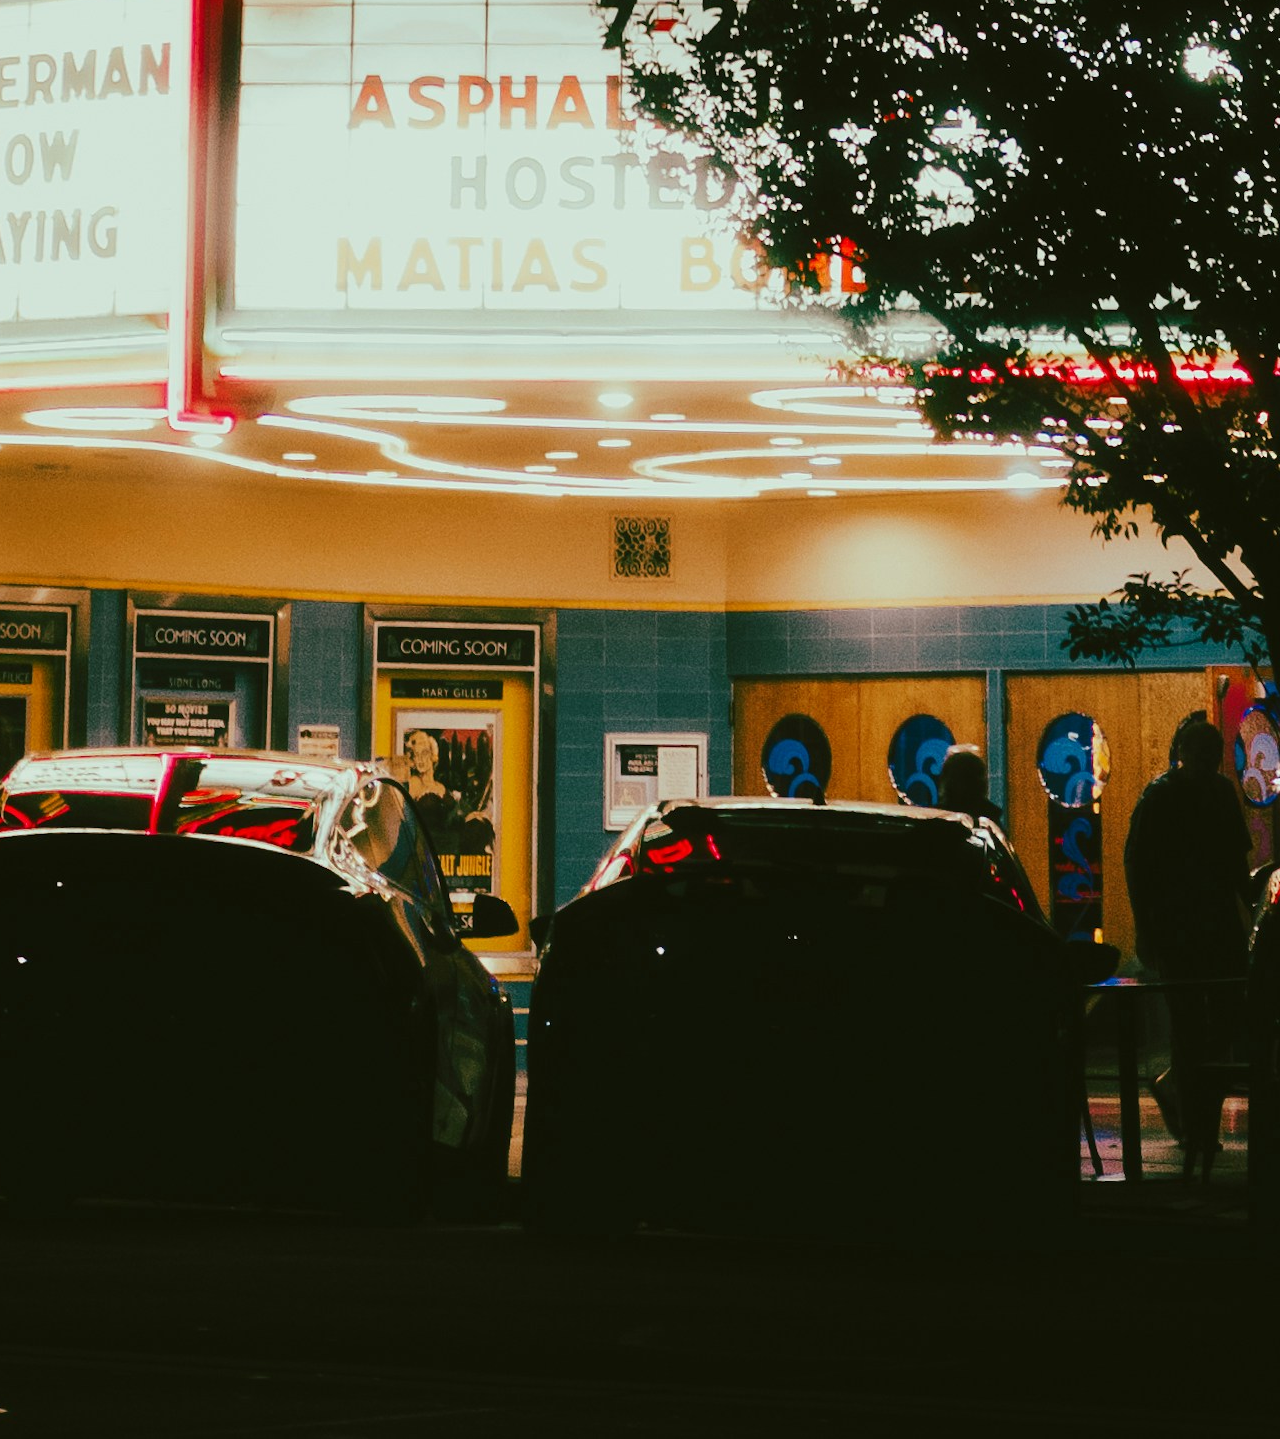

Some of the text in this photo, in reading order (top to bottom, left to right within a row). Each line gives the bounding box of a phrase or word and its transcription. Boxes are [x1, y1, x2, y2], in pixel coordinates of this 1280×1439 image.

[449, 154, 738, 210] HOSTED
[335, 237, 610, 294] MATIAS
[0, 622, 42, 640] SOON
[155, 628, 247, 647] COMING SOON
[400, 638, 508, 657] COMING SOON
[421, 687, 488, 699] MARY GILLES
[457, 853, 492, 877] JUNGLE
